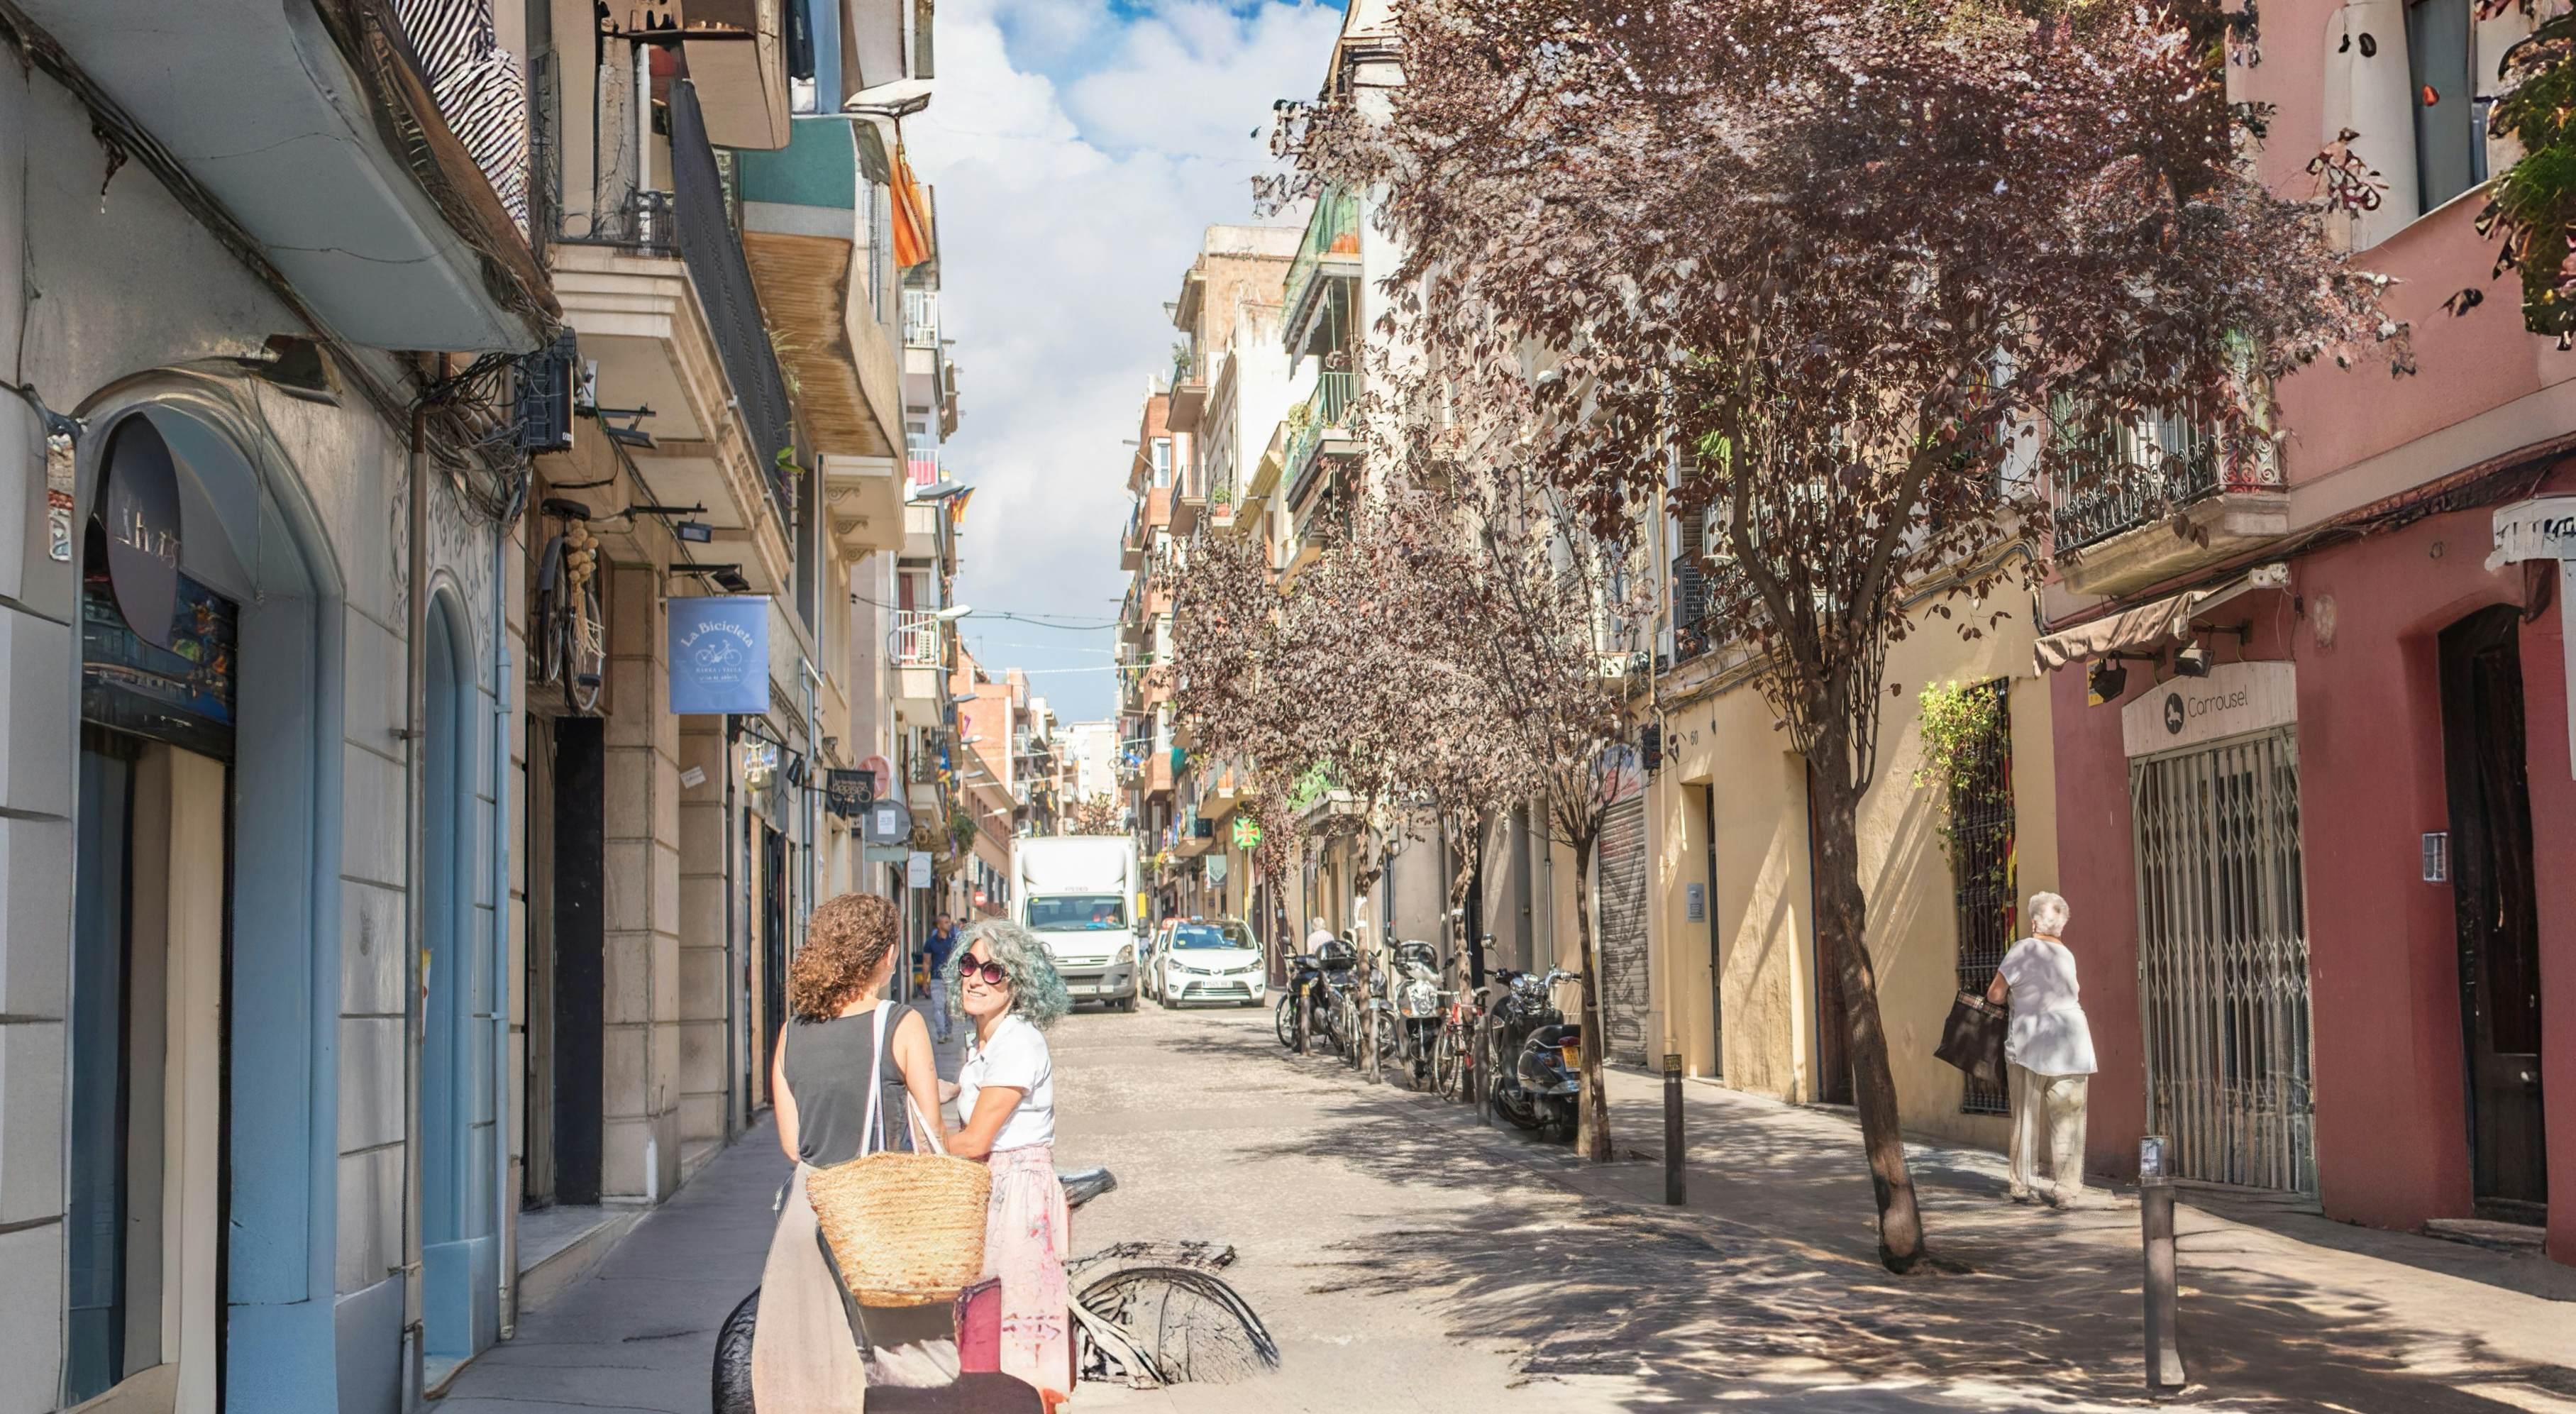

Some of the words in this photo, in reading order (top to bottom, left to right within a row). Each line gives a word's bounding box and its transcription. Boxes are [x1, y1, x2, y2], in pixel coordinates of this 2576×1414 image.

[681, 631, 700, 647] La
[698, 621, 753, 648] Bicicleta
[2188, 685, 2248, 718] Carrousel
[1691, 730, 1698, 746] 60
